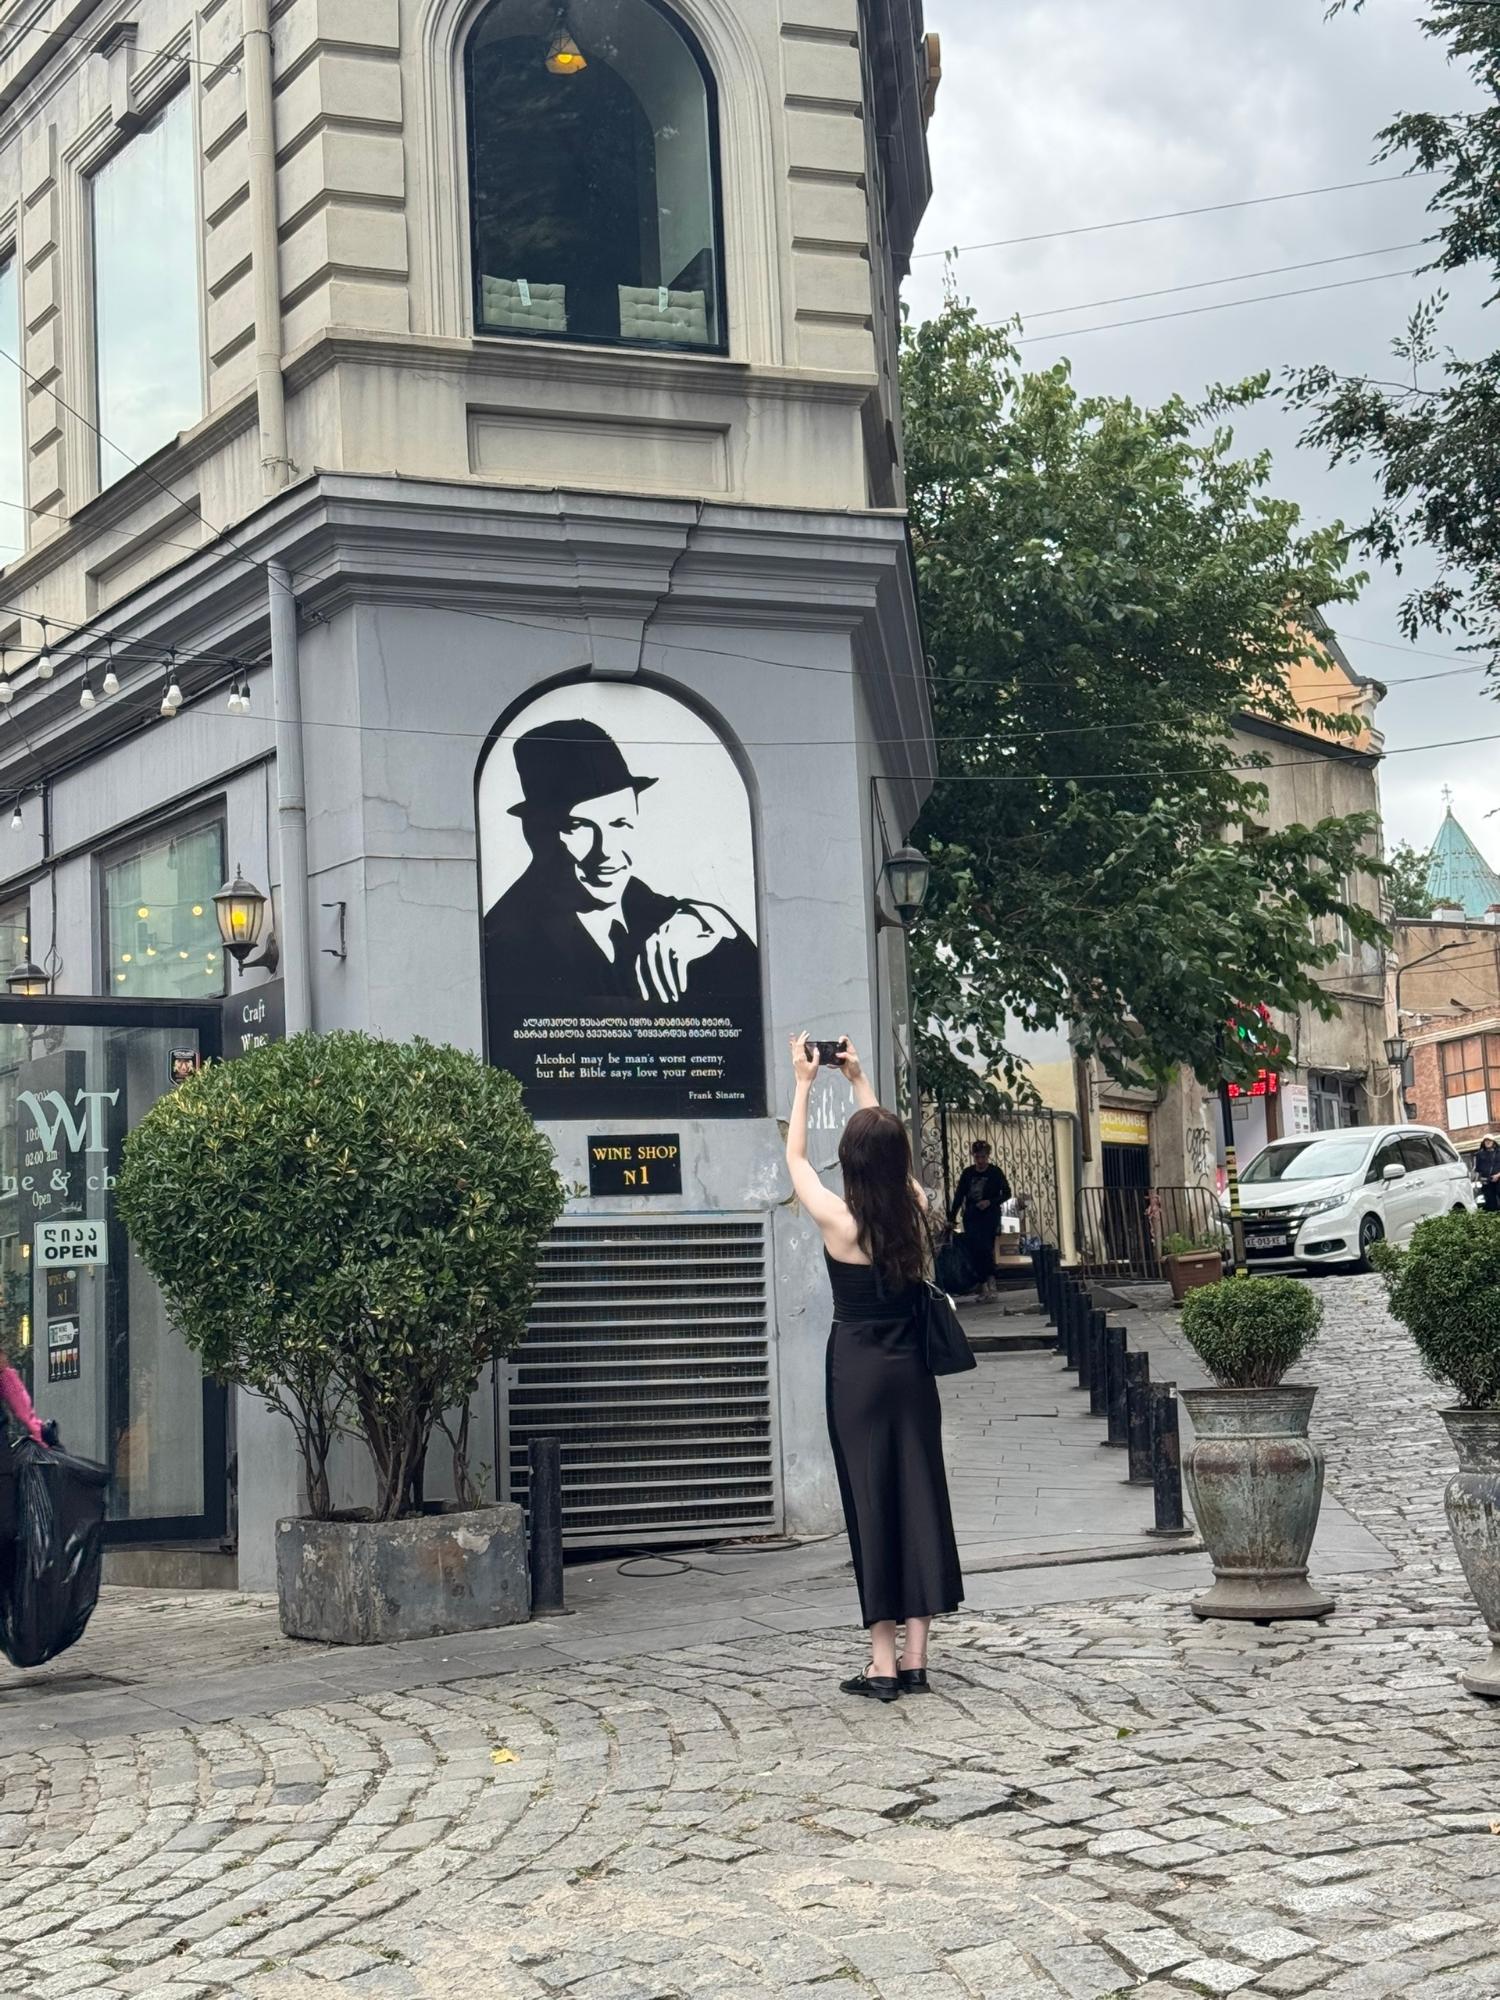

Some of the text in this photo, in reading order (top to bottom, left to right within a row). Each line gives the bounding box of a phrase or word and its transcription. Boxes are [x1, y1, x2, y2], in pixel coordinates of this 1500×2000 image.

[243, 999, 266, 1023] Craft
[535, 1053, 576, 1065] Alcohol
[581, 1056, 603, 1066] may
[608, 1053, 620, 1064] be
[625, 1054, 655, 1064] man's
[659, 1054, 686, 1064] worst
[536, 1067, 554, 1078] but
[559, 1067, 575, 1078] the
[580, 1066, 606, 1078] Bible
[610, 1069, 632, 1080] says
[637, 1066, 658, 1077] love
[663, 1069, 686, 1080] your
[689, 1090, 745, 1100] Frank Sinatra
[592, 1145, 677, 1160] WINE SHOP
[49, 1168, 72, 1197] &
[32, 1191, 52, 1210] Open
[44, 1228, 97, 1243] ღიაა
[44, 1245, 98, 1260] OPEN
